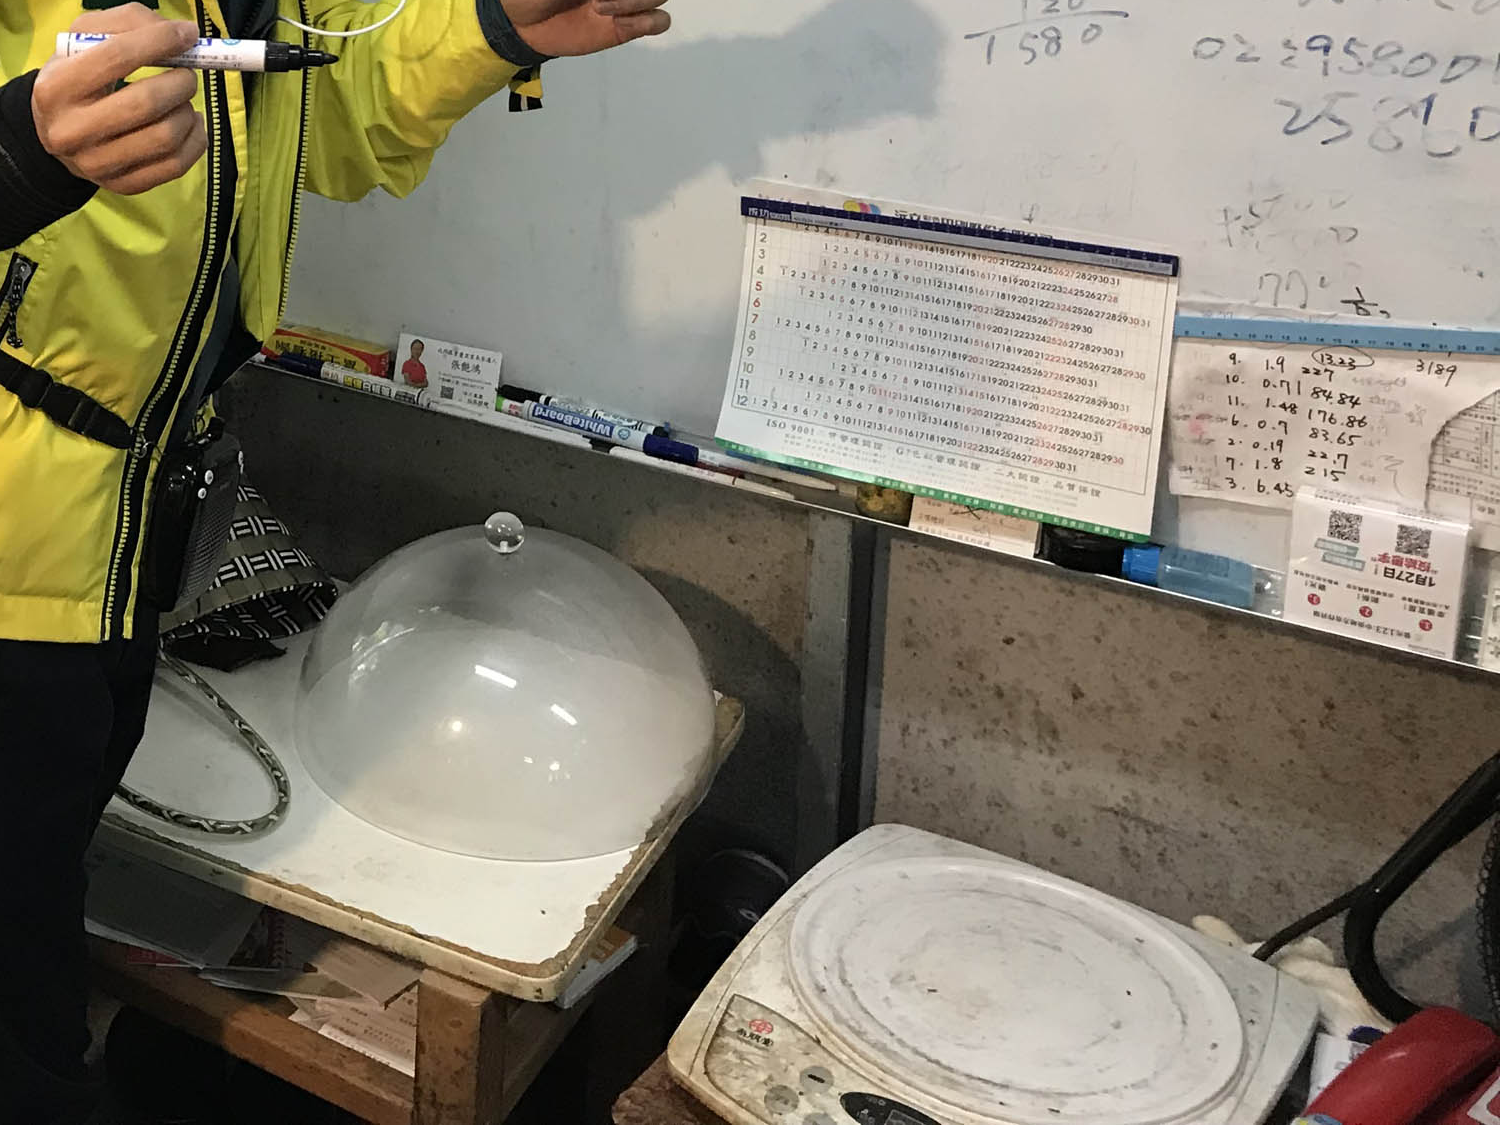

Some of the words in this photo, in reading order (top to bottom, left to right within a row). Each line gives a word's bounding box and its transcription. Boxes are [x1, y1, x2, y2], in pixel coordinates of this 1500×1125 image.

[742, 362, 754, 374] 10
[1416, 359, 1458, 387] 3189
[736, 394, 749, 406] 12
[1310, 386, 1361, 408] 84.84
[534, 403, 612, 438] WhiteBoard
[1308, 427, 1363, 446] 83.65
